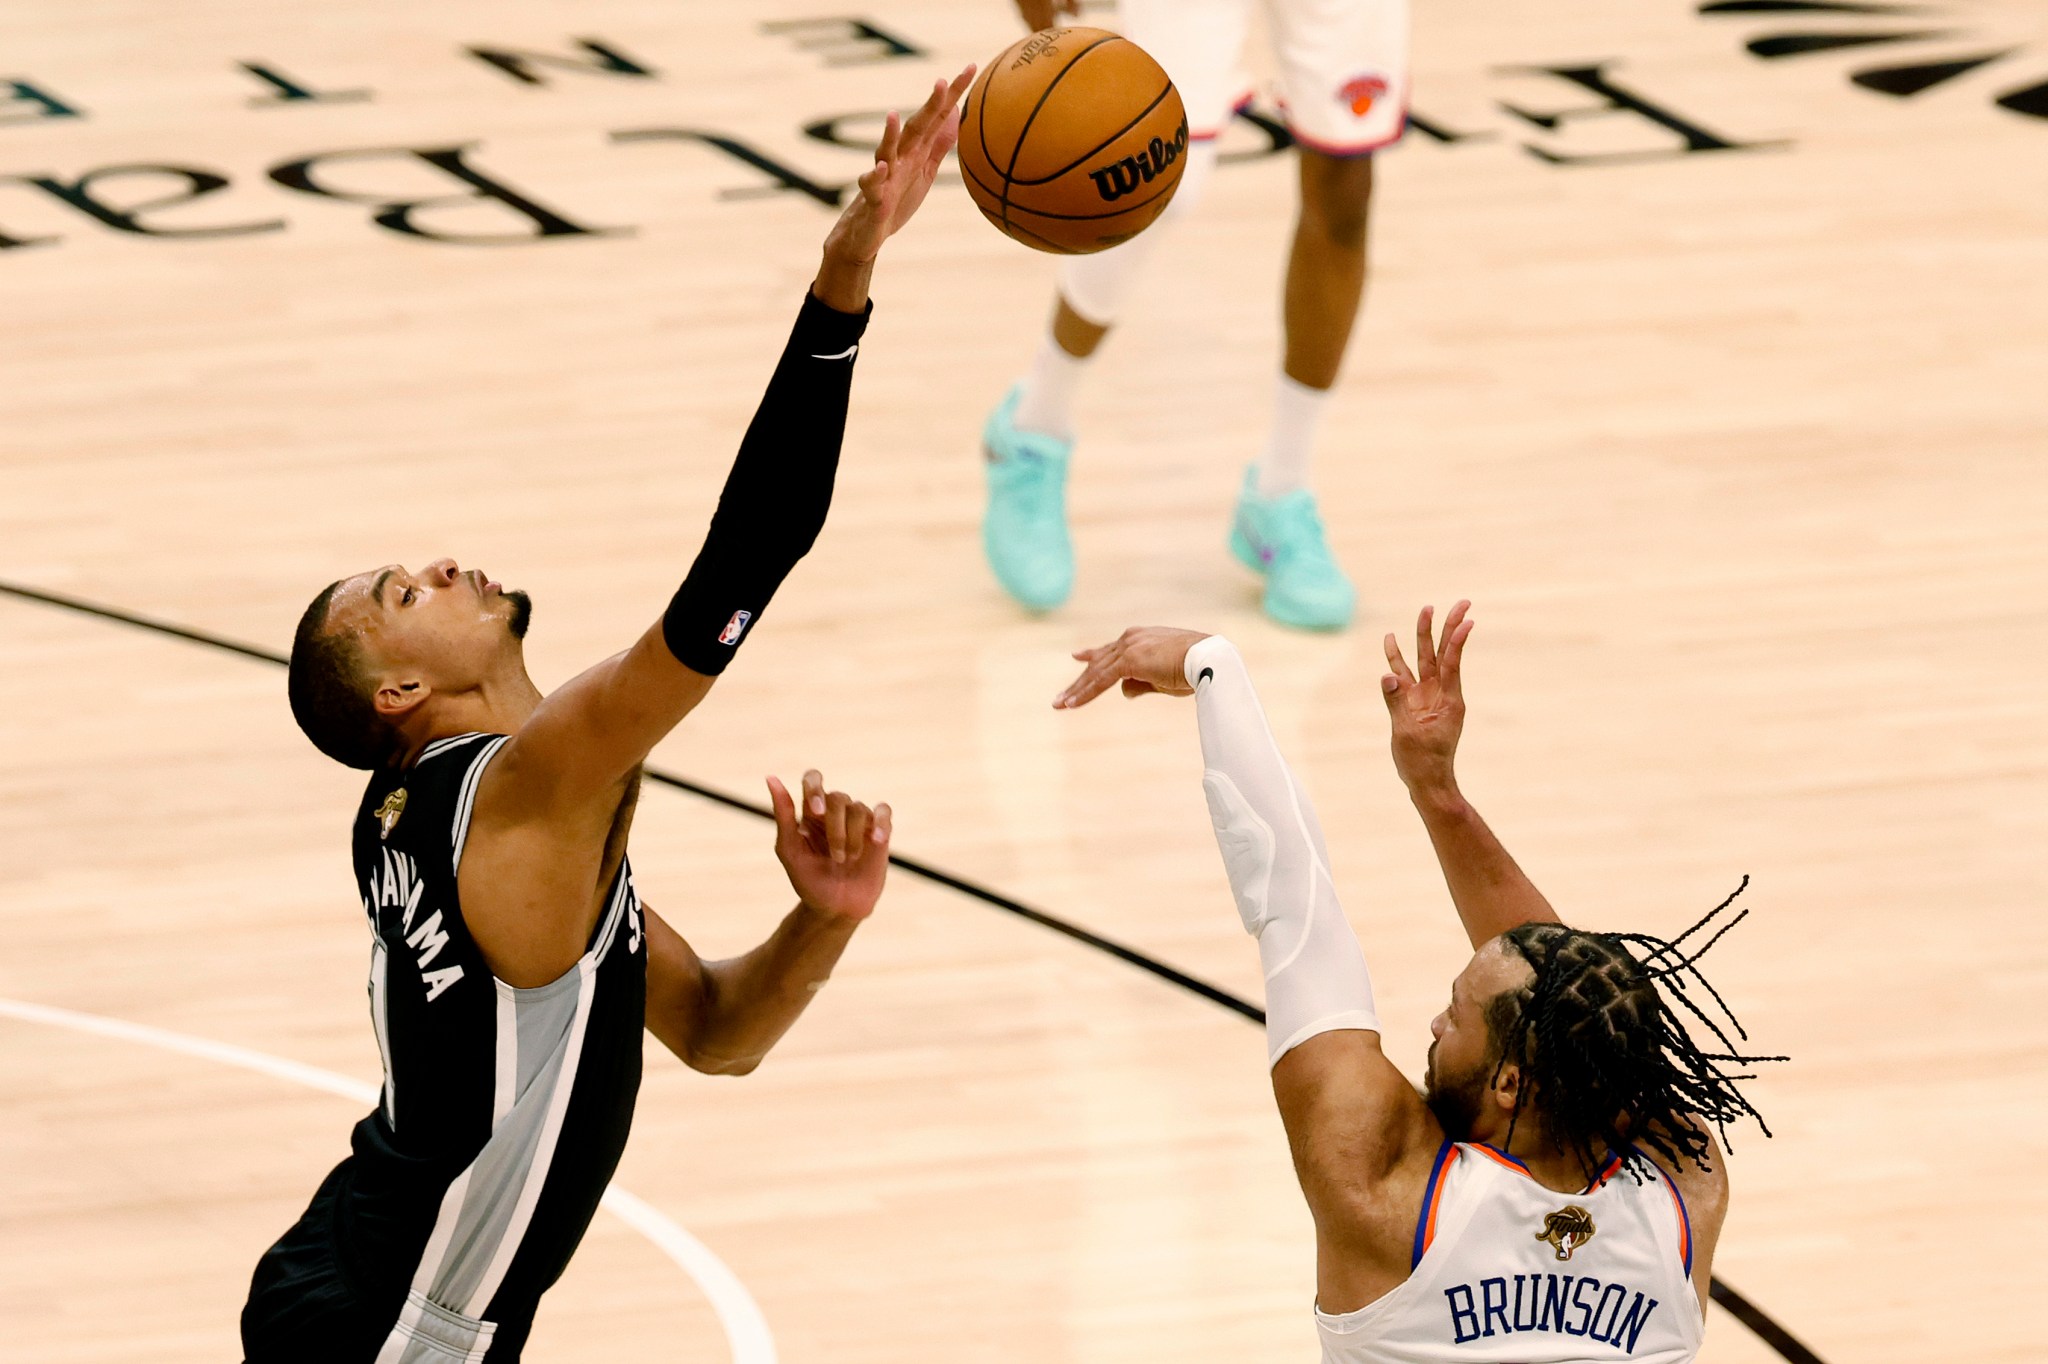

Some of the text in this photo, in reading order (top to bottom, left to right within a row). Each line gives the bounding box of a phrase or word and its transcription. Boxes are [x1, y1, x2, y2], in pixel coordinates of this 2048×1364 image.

[0, 141, 637, 248] Ba
[1537, 1213, 1596, 1240] Finals
[1444, 1273, 1659, 1355] BRUNSON
